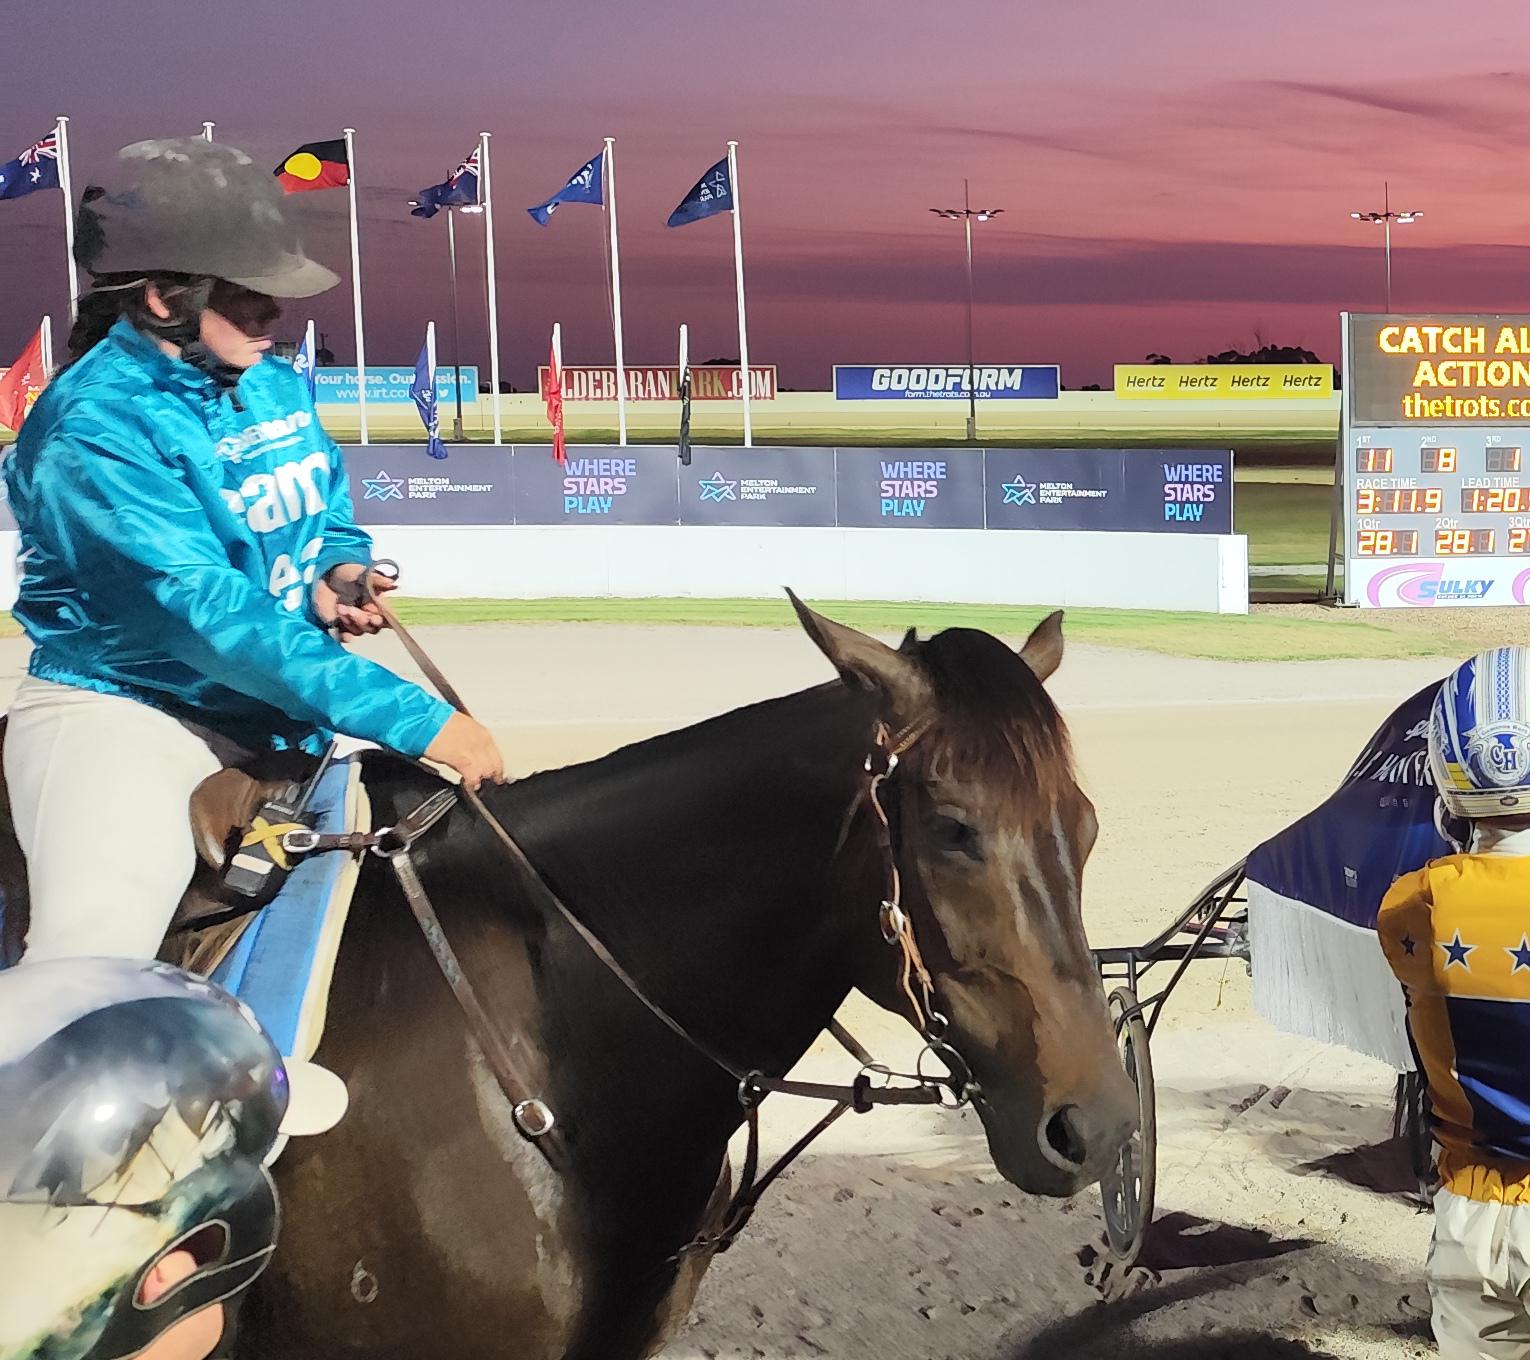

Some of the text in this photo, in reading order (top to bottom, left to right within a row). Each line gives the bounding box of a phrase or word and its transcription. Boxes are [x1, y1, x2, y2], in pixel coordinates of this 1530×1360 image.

[1379, 326, 1485, 354] CATCH
[871, 368, 1023, 391] GOODFORM
[1126, 374, 1323, 388] Hertz Hertz Hertz Hertz
[564, 459, 637, 476] WHERE
[1367, 448, 1391, 472] 11
[1437, 448, 1455, 472] 8
[1513, 448, 1521, 471] 1
[880, 461, 947, 479] WHERE
[1163, 464, 1223, 482] WHERE
[408, 477, 449, 485] MELTON
[563, 477, 627, 494] STARS
[880, 480, 938, 497] STARS
[1039, 482, 1073, 490] MELTON
[1356, 478, 1417, 489] RACE TIME
[1461, 477, 1519, 488] LEAD TIME
[408, 491, 437, 499] PARK
[740, 486, 817, 494] ENTERTAINMENT
[1164, 483, 1215, 502] STARS
[564, 496, 613, 513] PLAY
[881, 499, 925, 516] PLAY
[1357, 489, 1441, 513] 3:11.9
[1164, 503, 1203, 521] PLAY
[1358, 518, 1381, 529] 1Qtr
[1435, 517, 1459, 529] 2Qtr
[1357, 530, 1418, 555] 28.1
[1435, 530, 1495, 554] 28.1
[1417, 579, 1495, 599] SULKY
